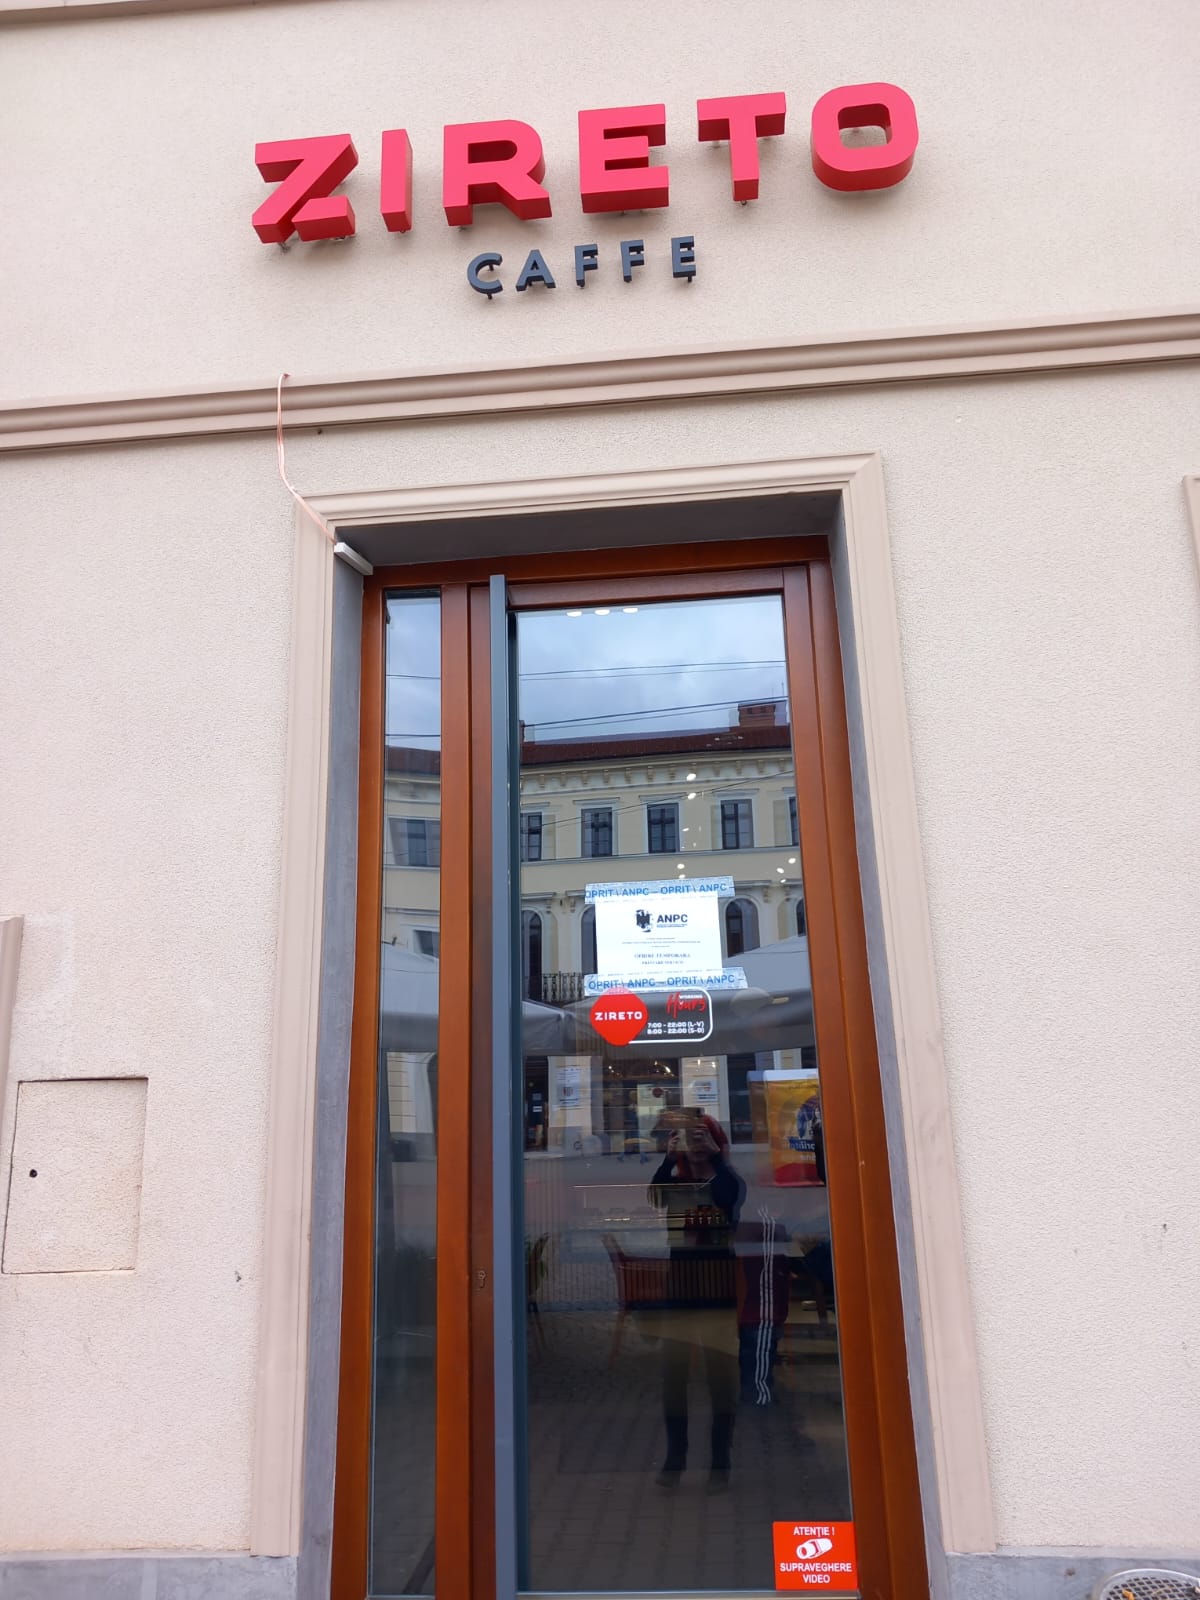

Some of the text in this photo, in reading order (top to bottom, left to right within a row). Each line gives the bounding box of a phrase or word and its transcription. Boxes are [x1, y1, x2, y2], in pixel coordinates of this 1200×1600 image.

[252, 82, 919, 244] ZIRETO
[467, 235, 697, 295] CAFFE
[621, 887, 650, 897] ANPC
[660, 884, 691, 895] OPRIT
[699, 882, 728, 893] ANPC
[657, 914, 688, 923] ANPC
[588, 978, 619, 990] OPRIT
[627, 977, 656, 988] ANPC
[667, 975, 698, 986] OPRIT
[706, 974, 735, 984] ANPC
[594, 1011, 643, 1021] ZIRETO
[780, 1562, 853, 1572] SUPRAVEGHERE
[802, 1574, 831, 1584] VIDEO
